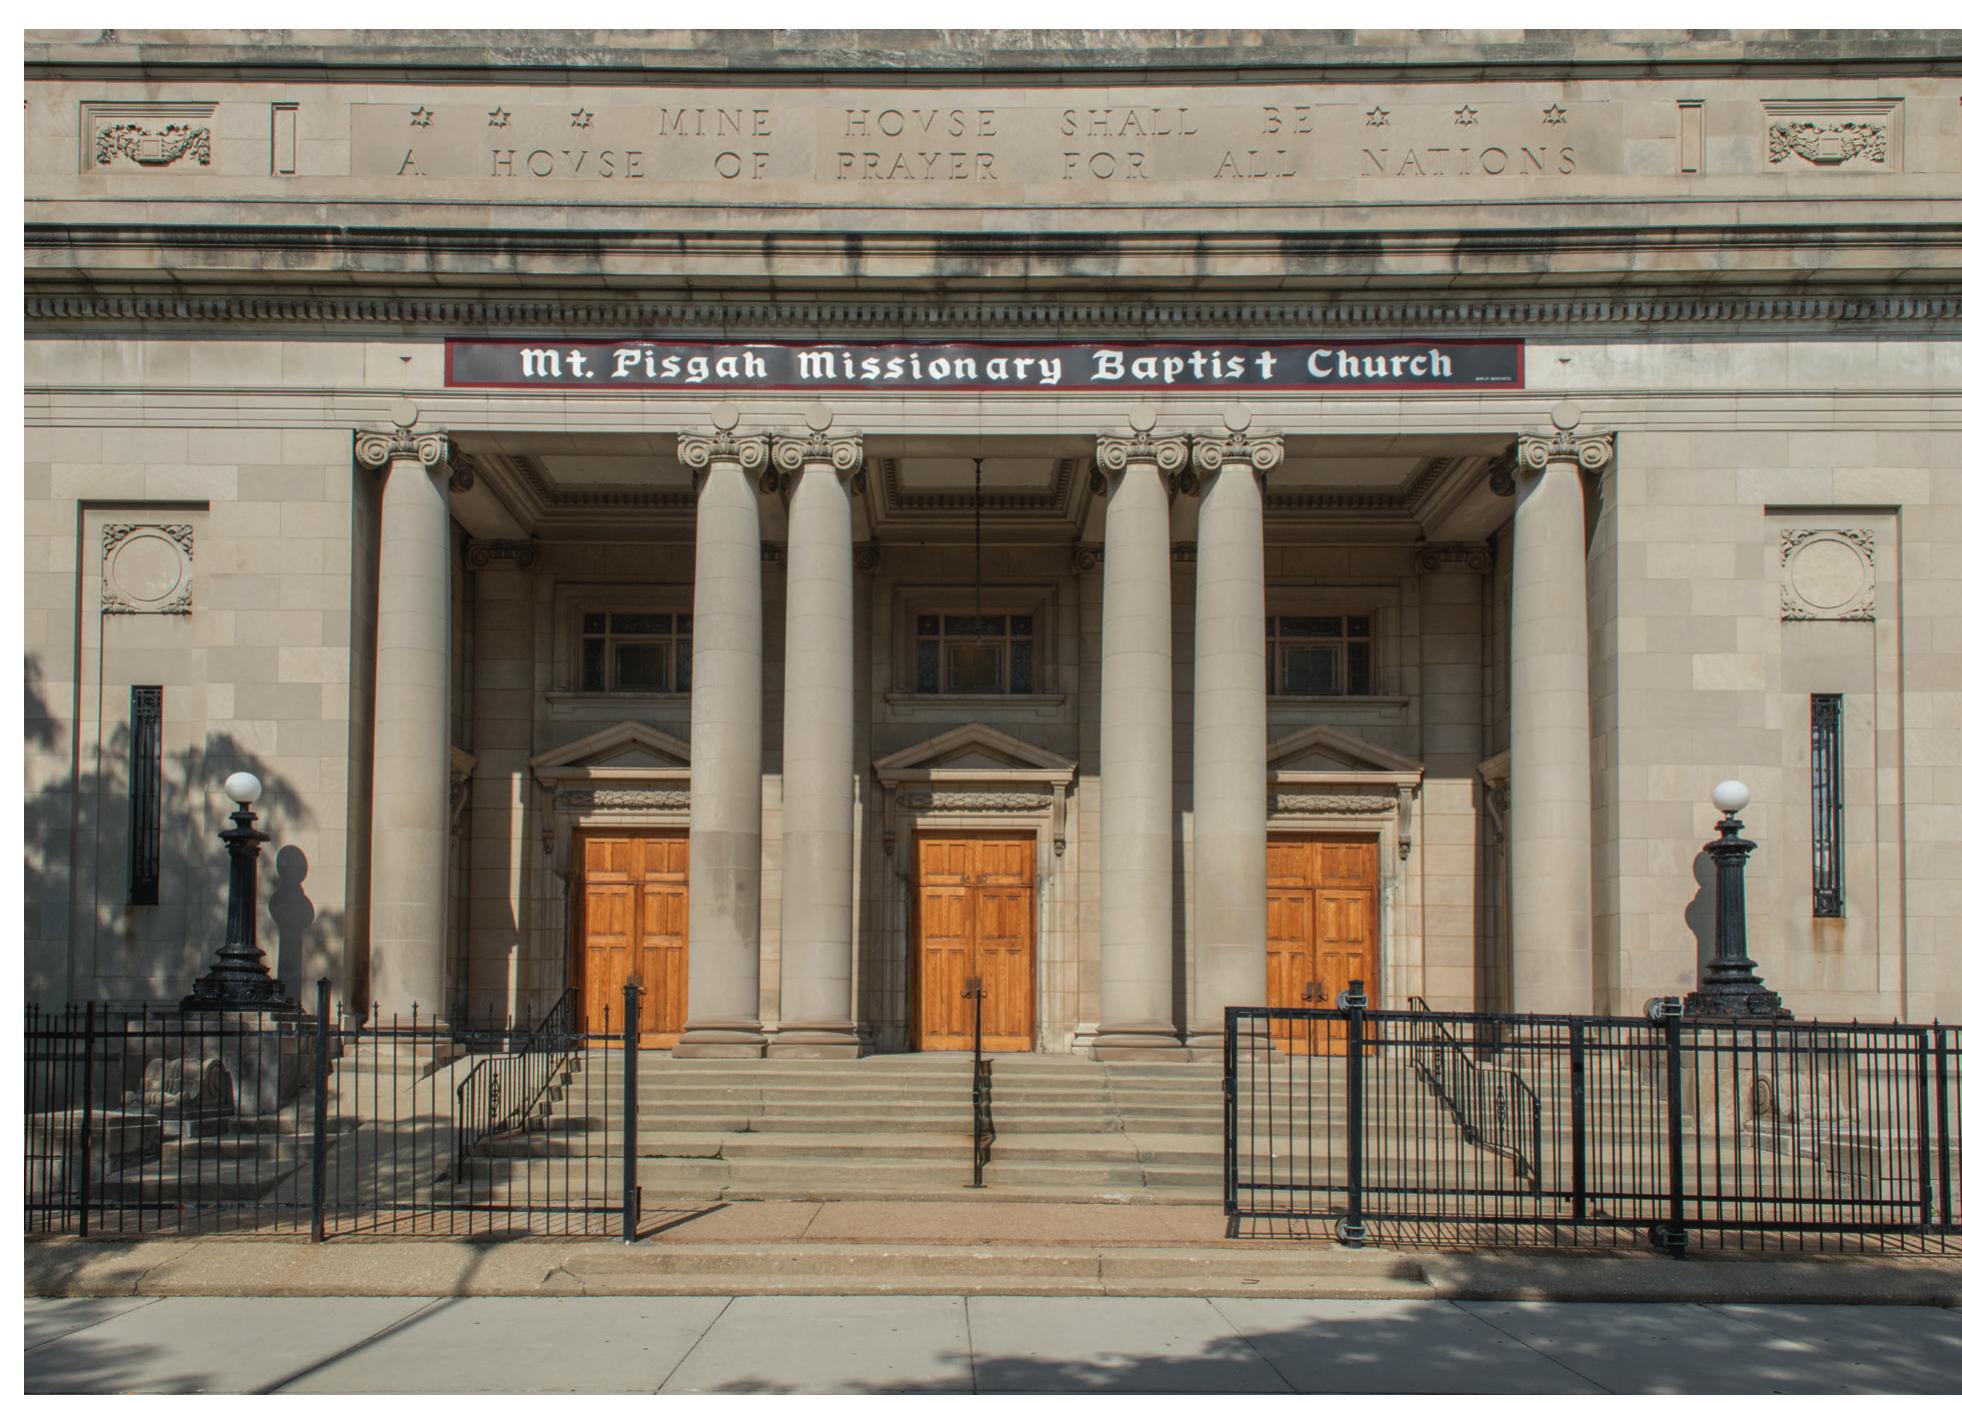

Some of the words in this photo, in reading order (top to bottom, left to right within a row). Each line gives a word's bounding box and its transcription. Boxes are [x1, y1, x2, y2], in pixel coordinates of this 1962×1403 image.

[660, 108, 773, 137] MINE
[1062, 108, 1199, 136] SHALL
[1262, 106, 1314, 134] BE
[396, 149, 427, 176] A
[714, 151, 770, 180] OF
[836, 152, 999, 180] PRAYER
[1062, 152, 1149, 180] FOR
[1214, 150, 1297, 179] ALL
[1361, 147, 1578, 177] NATIONS
[521, 348, 594, 378] Mt.
[611, 349, 768, 383] Pisgah
[799, 350, 1062, 384] Missionary
[1090, 349, 1278, 384] Baptist
[1307, 348, 1453, 378] Church
